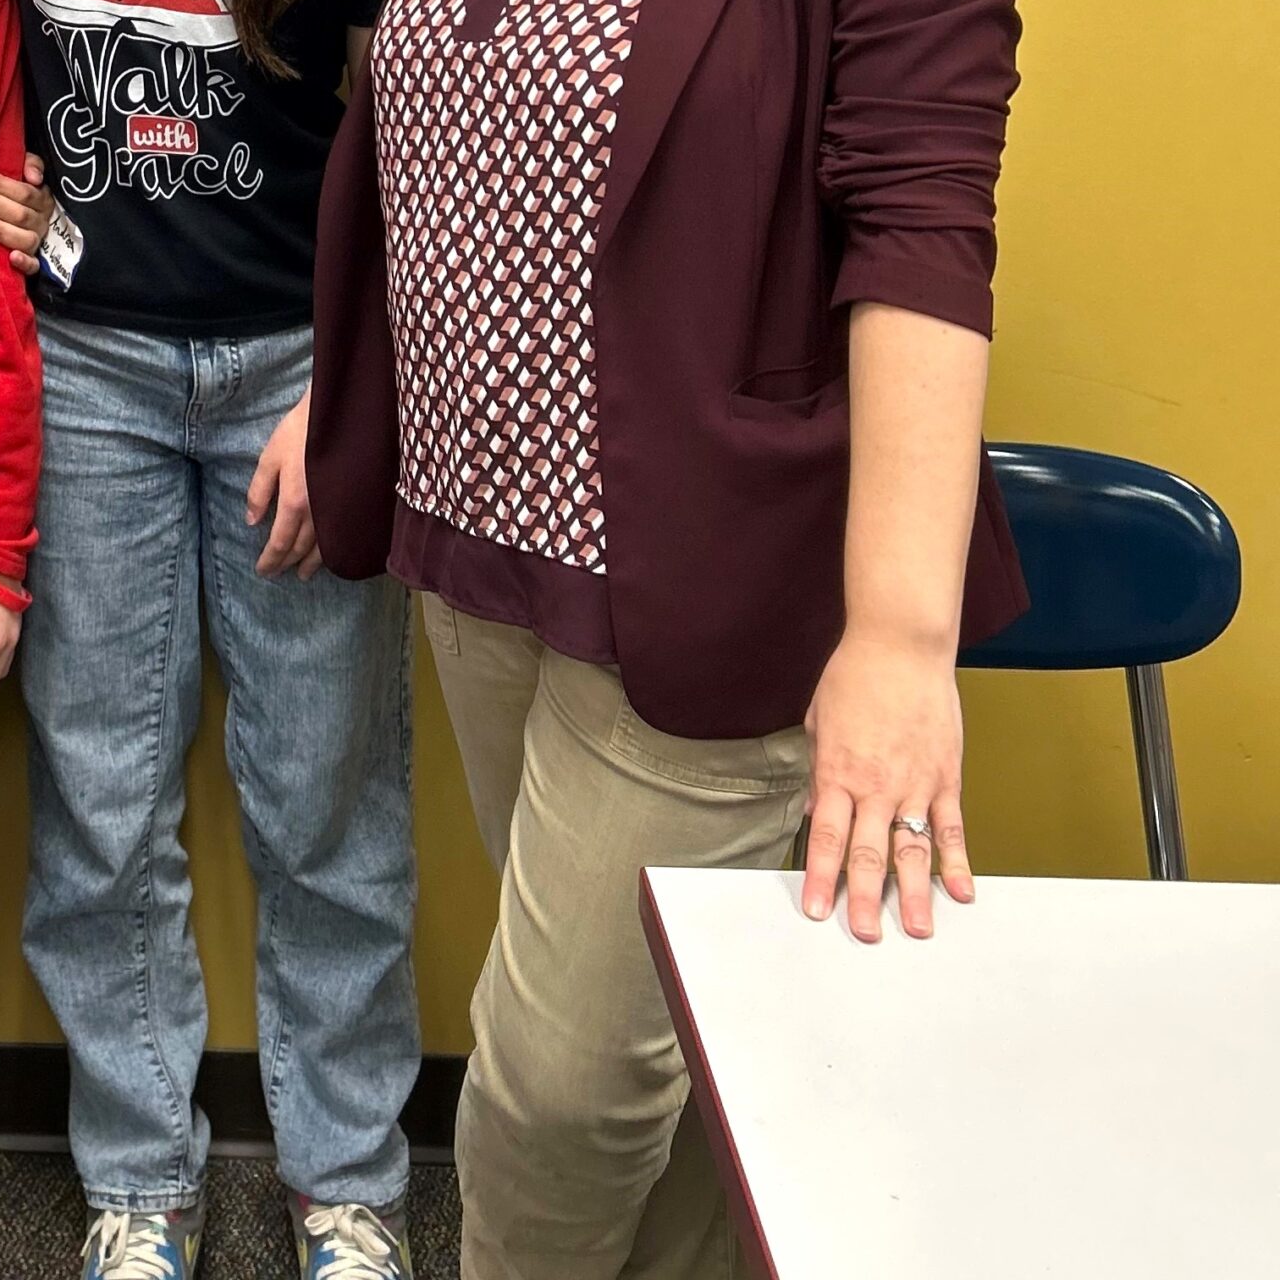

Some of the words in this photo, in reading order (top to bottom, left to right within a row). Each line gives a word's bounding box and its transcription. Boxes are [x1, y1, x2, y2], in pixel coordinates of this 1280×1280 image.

[41, 19, 246, 128] Walk
[47, 93, 264, 201] Grace
[132, 121, 195, 150] with
